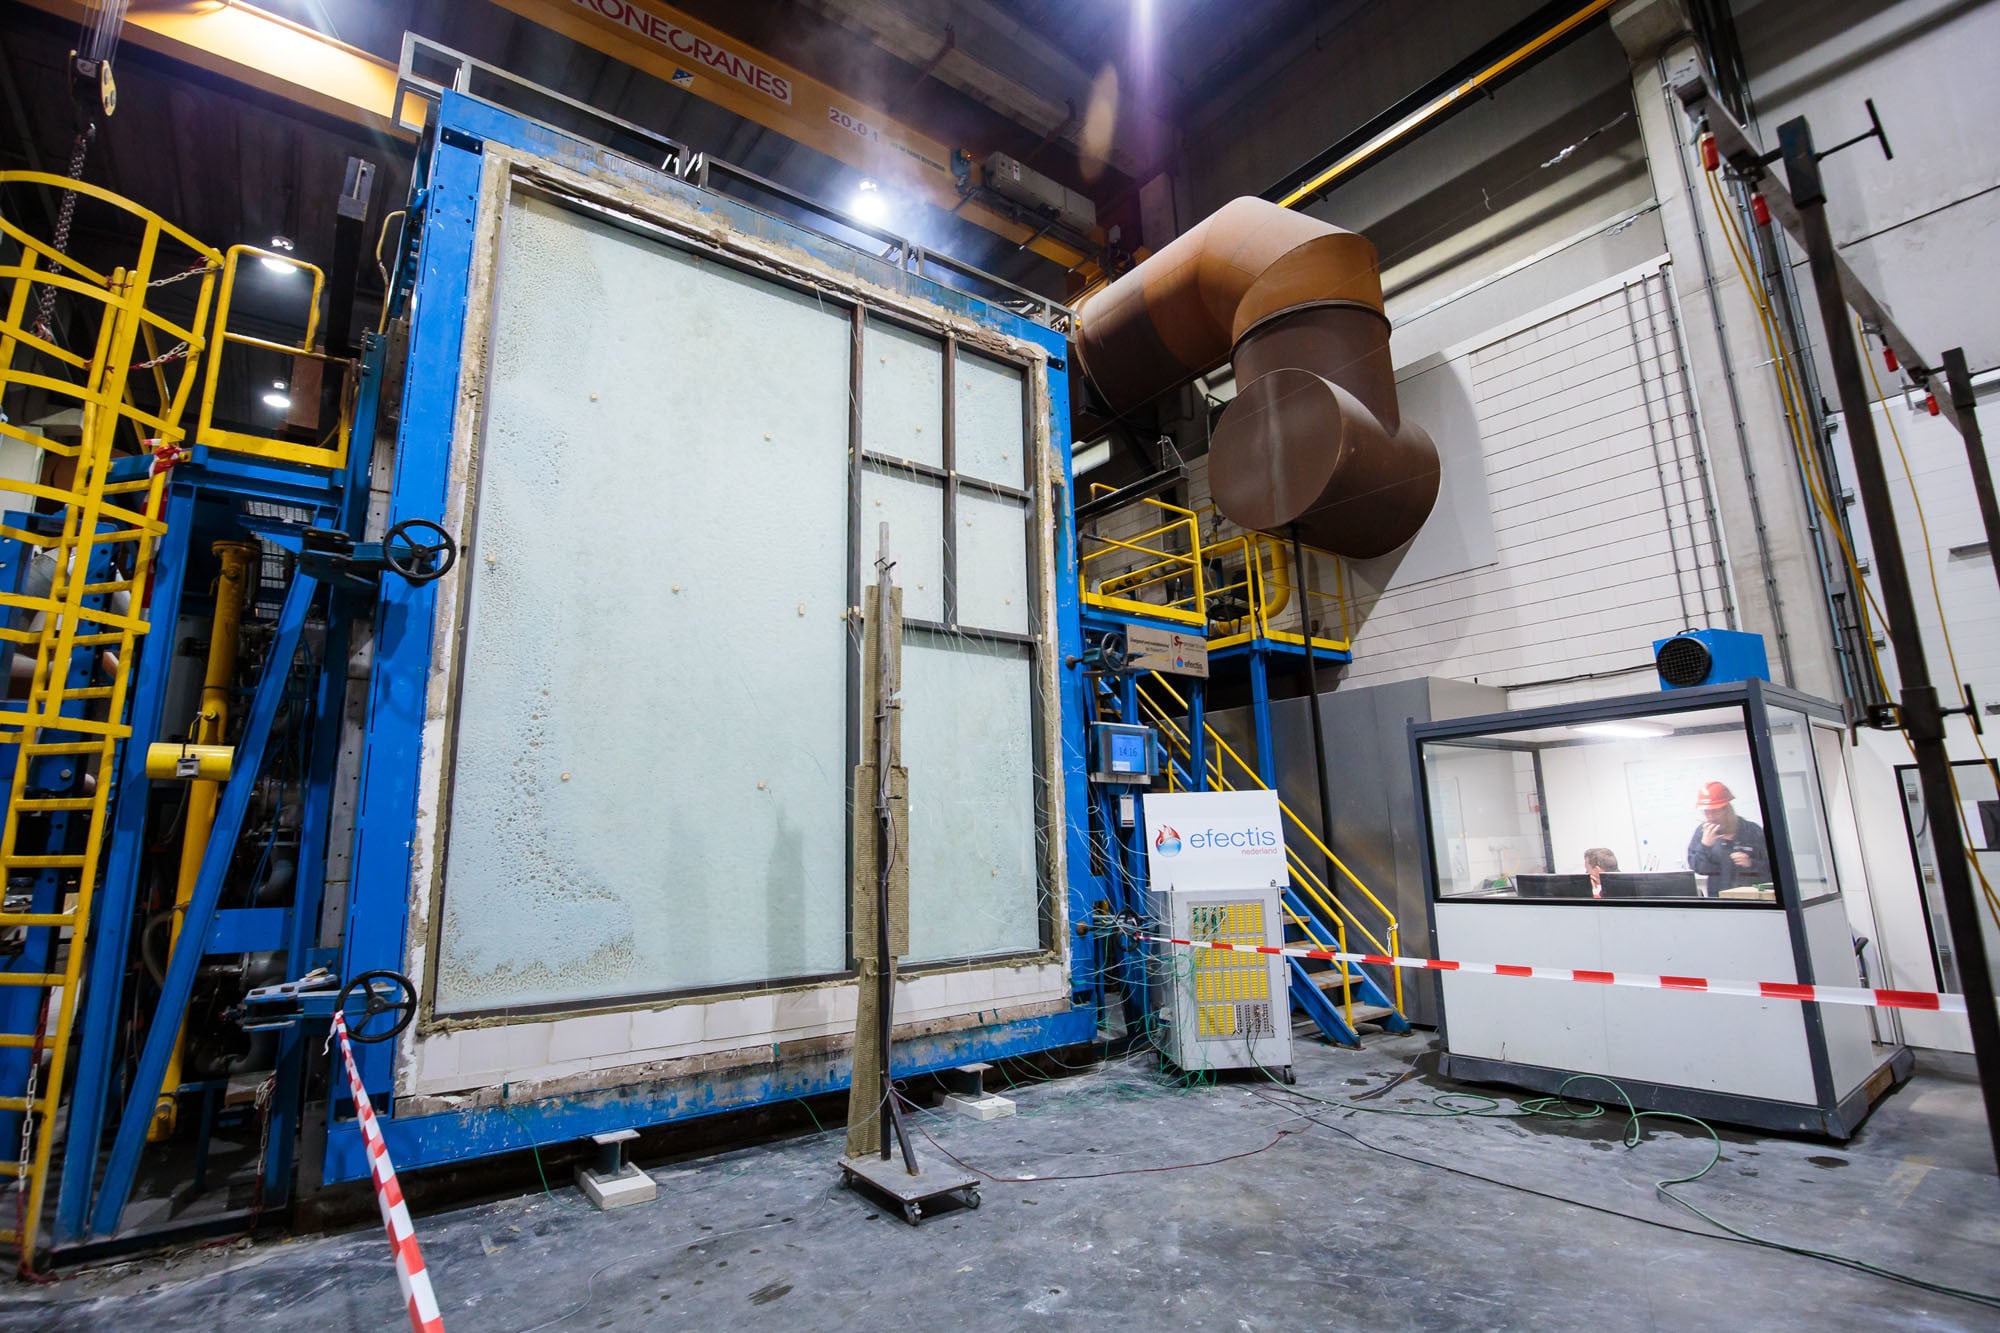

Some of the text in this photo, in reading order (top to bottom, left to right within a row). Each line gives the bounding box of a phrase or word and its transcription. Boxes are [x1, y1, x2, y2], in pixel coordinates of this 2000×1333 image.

[830, 109, 868, 136] 20.0
[1190, 827, 1276, 848] efectis
[1241, 847, 1278, 856] nederland
